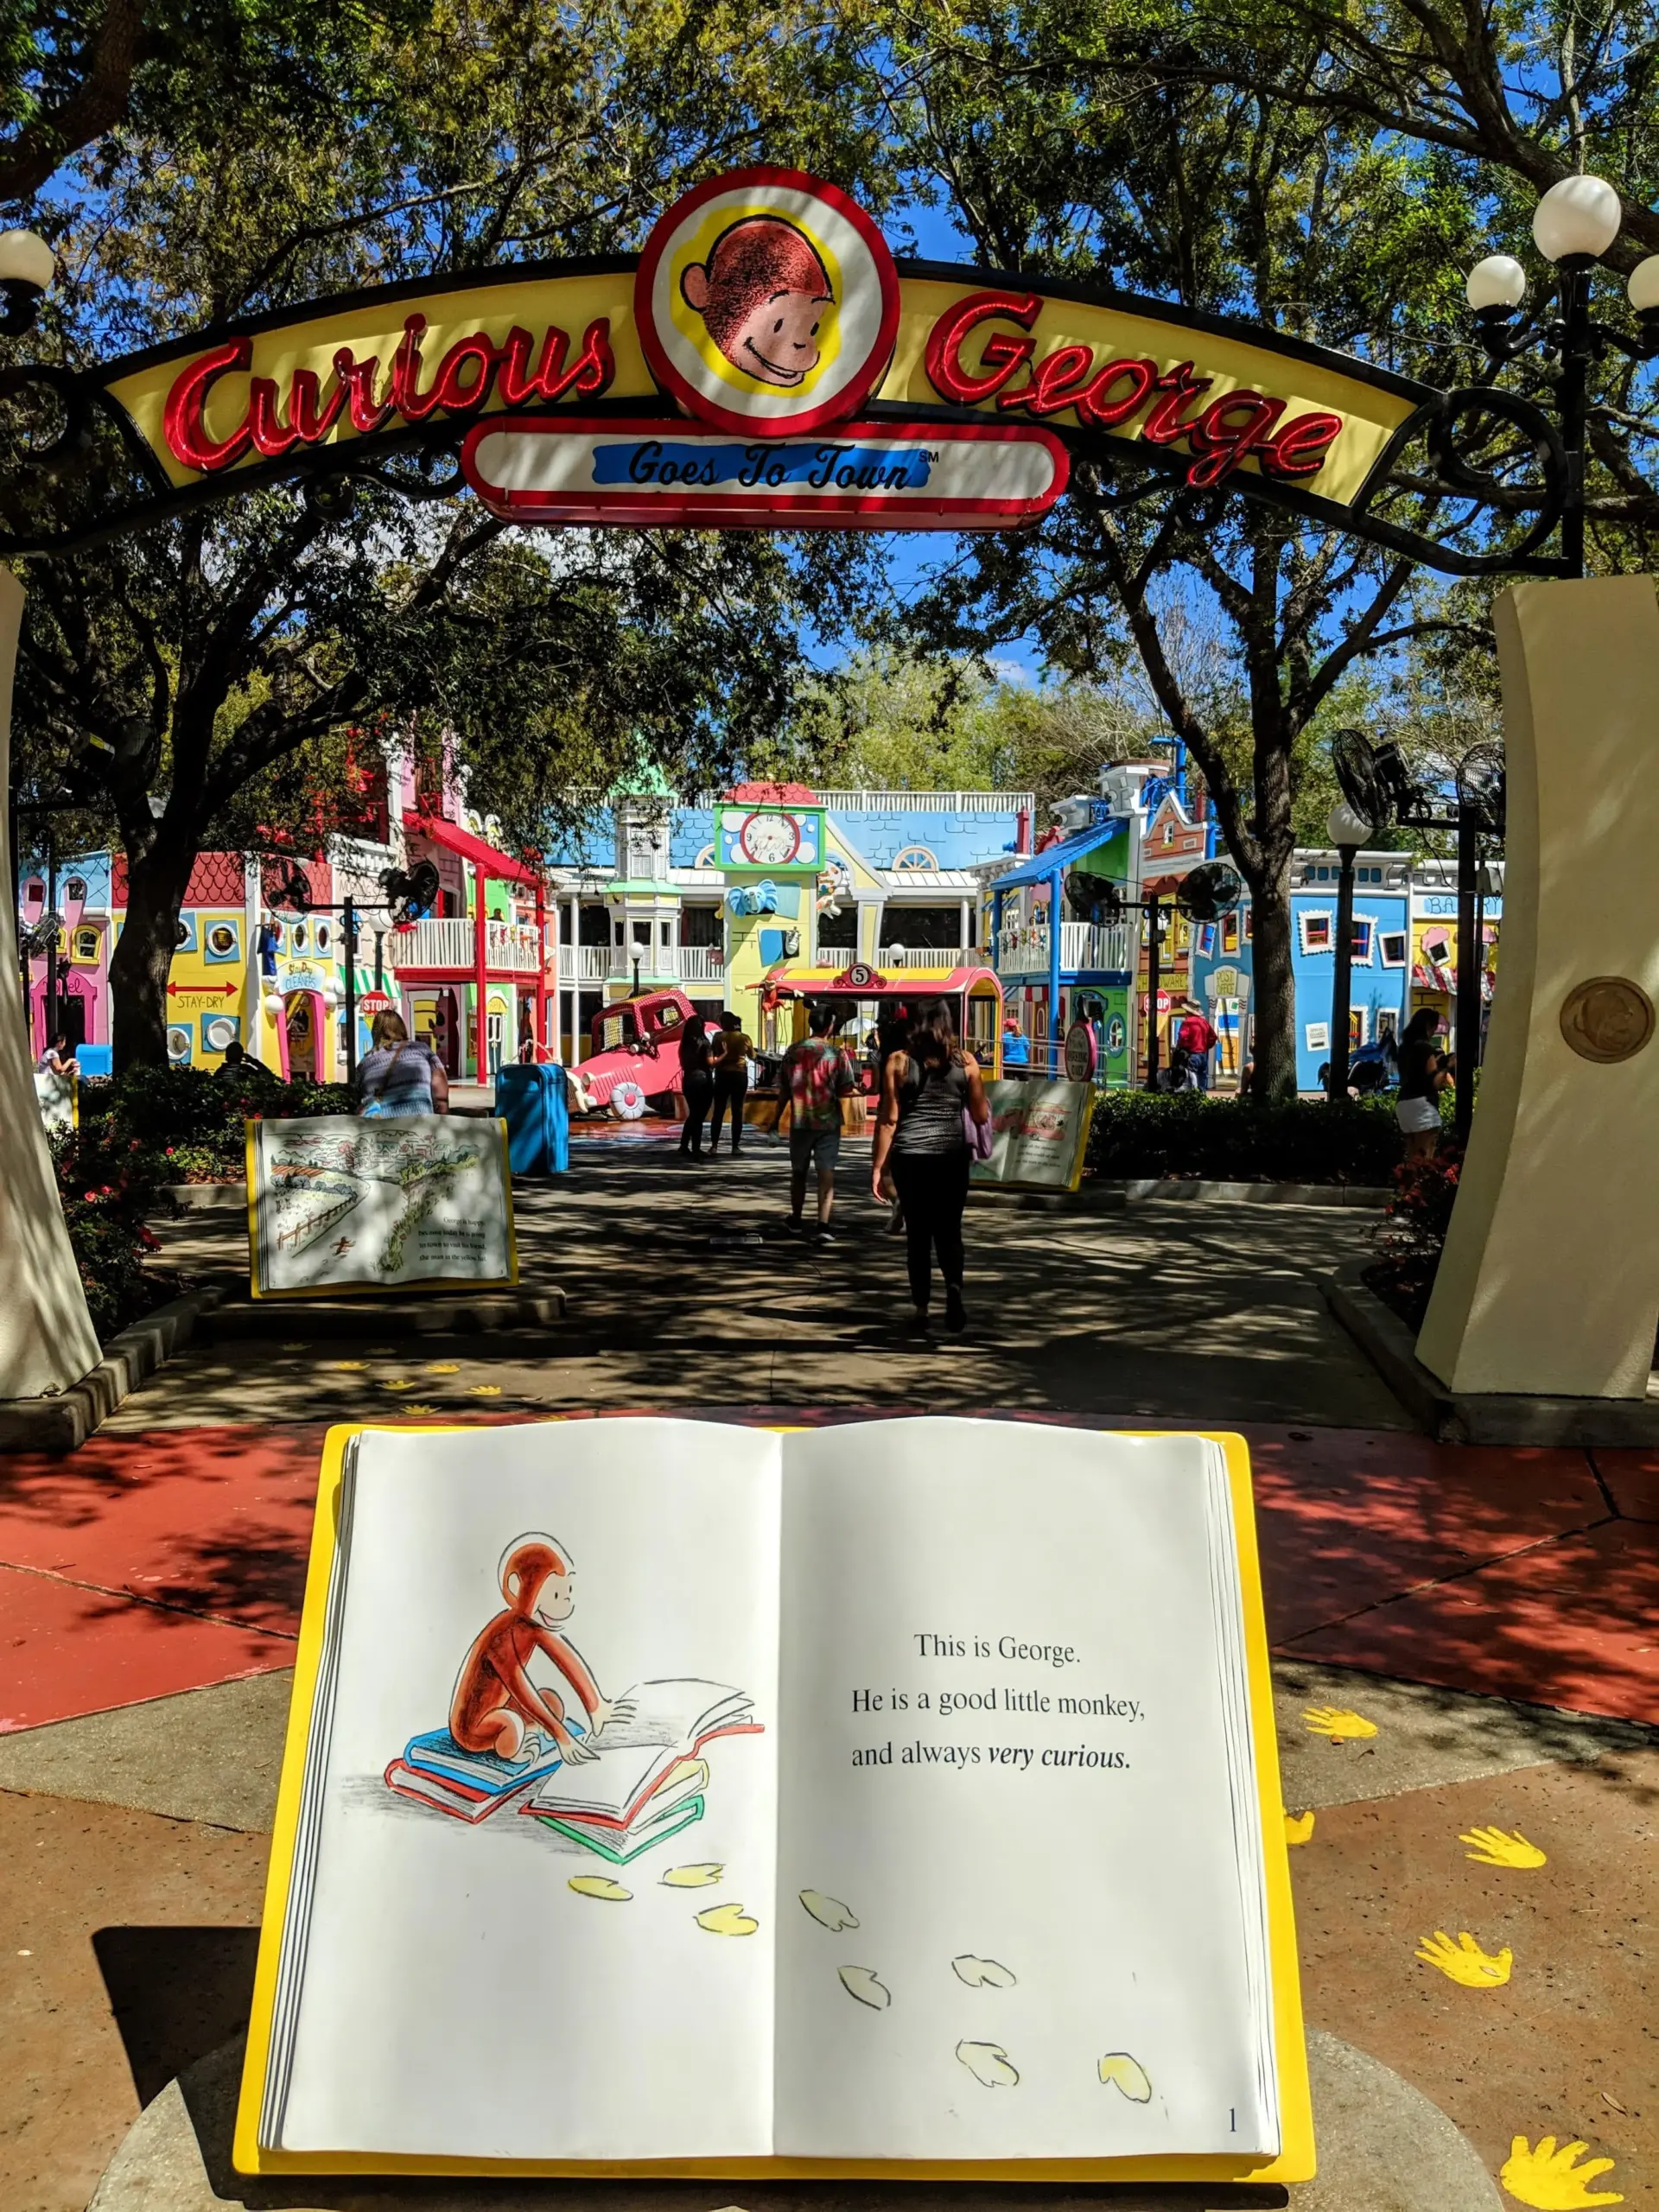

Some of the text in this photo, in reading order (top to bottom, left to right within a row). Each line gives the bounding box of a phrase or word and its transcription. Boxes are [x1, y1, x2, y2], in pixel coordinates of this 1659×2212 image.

[163, 290, 1343, 489] Curious George
[628, 441, 939, 490] Goes To Town SM
[747, 833, 753, 842] 9
[788, 832, 795, 841] 3
[768, 853, 775, 862] 6
[1428, 897, 1503, 915] BARY
[855, 969, 864, 982] 5
[176, 995, 225, 1008] STAY-DRY
[363, 999, 390, 1011] STOP
[913, 1633, 1081, 1669] This is George.
[851, 1688, 1146, 1722] He is a good little monkey,
[851, 1740, 1131, 1770] and always very curious.
